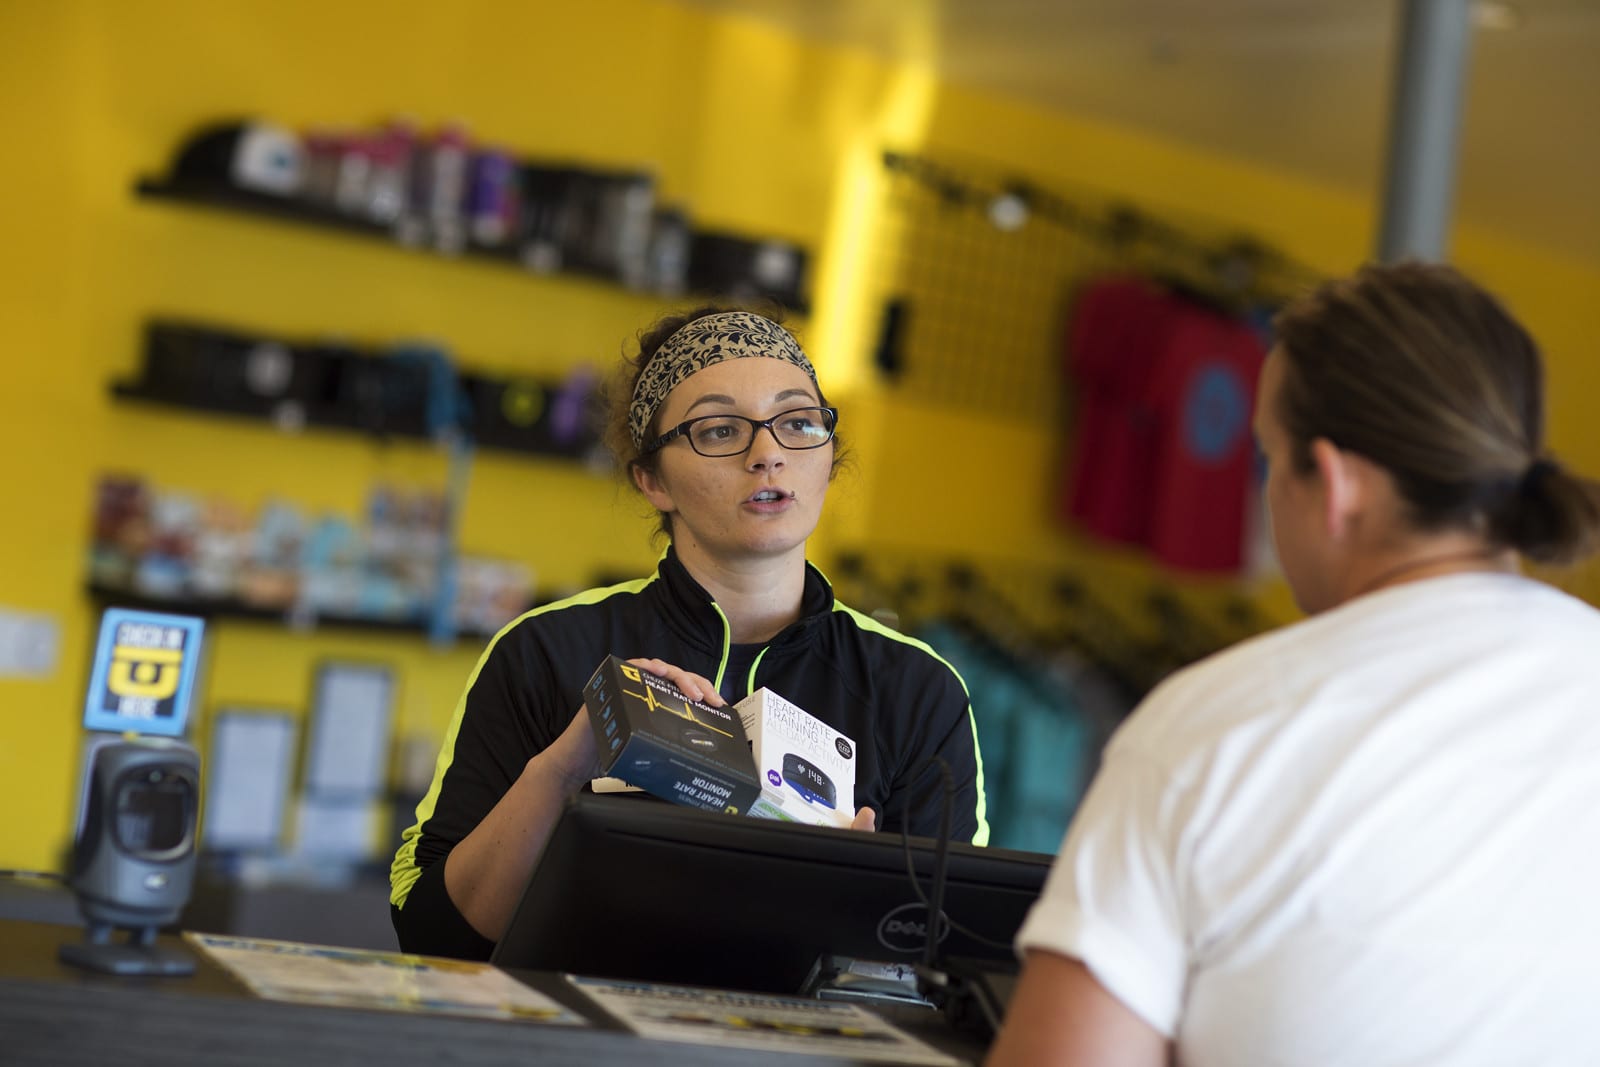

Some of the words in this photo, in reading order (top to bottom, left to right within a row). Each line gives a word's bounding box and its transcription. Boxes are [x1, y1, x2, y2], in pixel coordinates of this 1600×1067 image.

[645, 680, 671, 695] HEART
[673, 692, 694, 705] RATE
[694, 702, 732, 720] MONITOR
[767, 694, 803, 719] HEART
[804, 715, 831, 741] RATE
[767, 706, 819, 744] TRAINING
[808, 742, 852, 776] ACTIVITY
[672, 780, 697, 797] RATE
[691, 776, 732, 799] MONITOR
[696, 790, 726, 808] HEART
[886, 919, 928, 936] DEL
